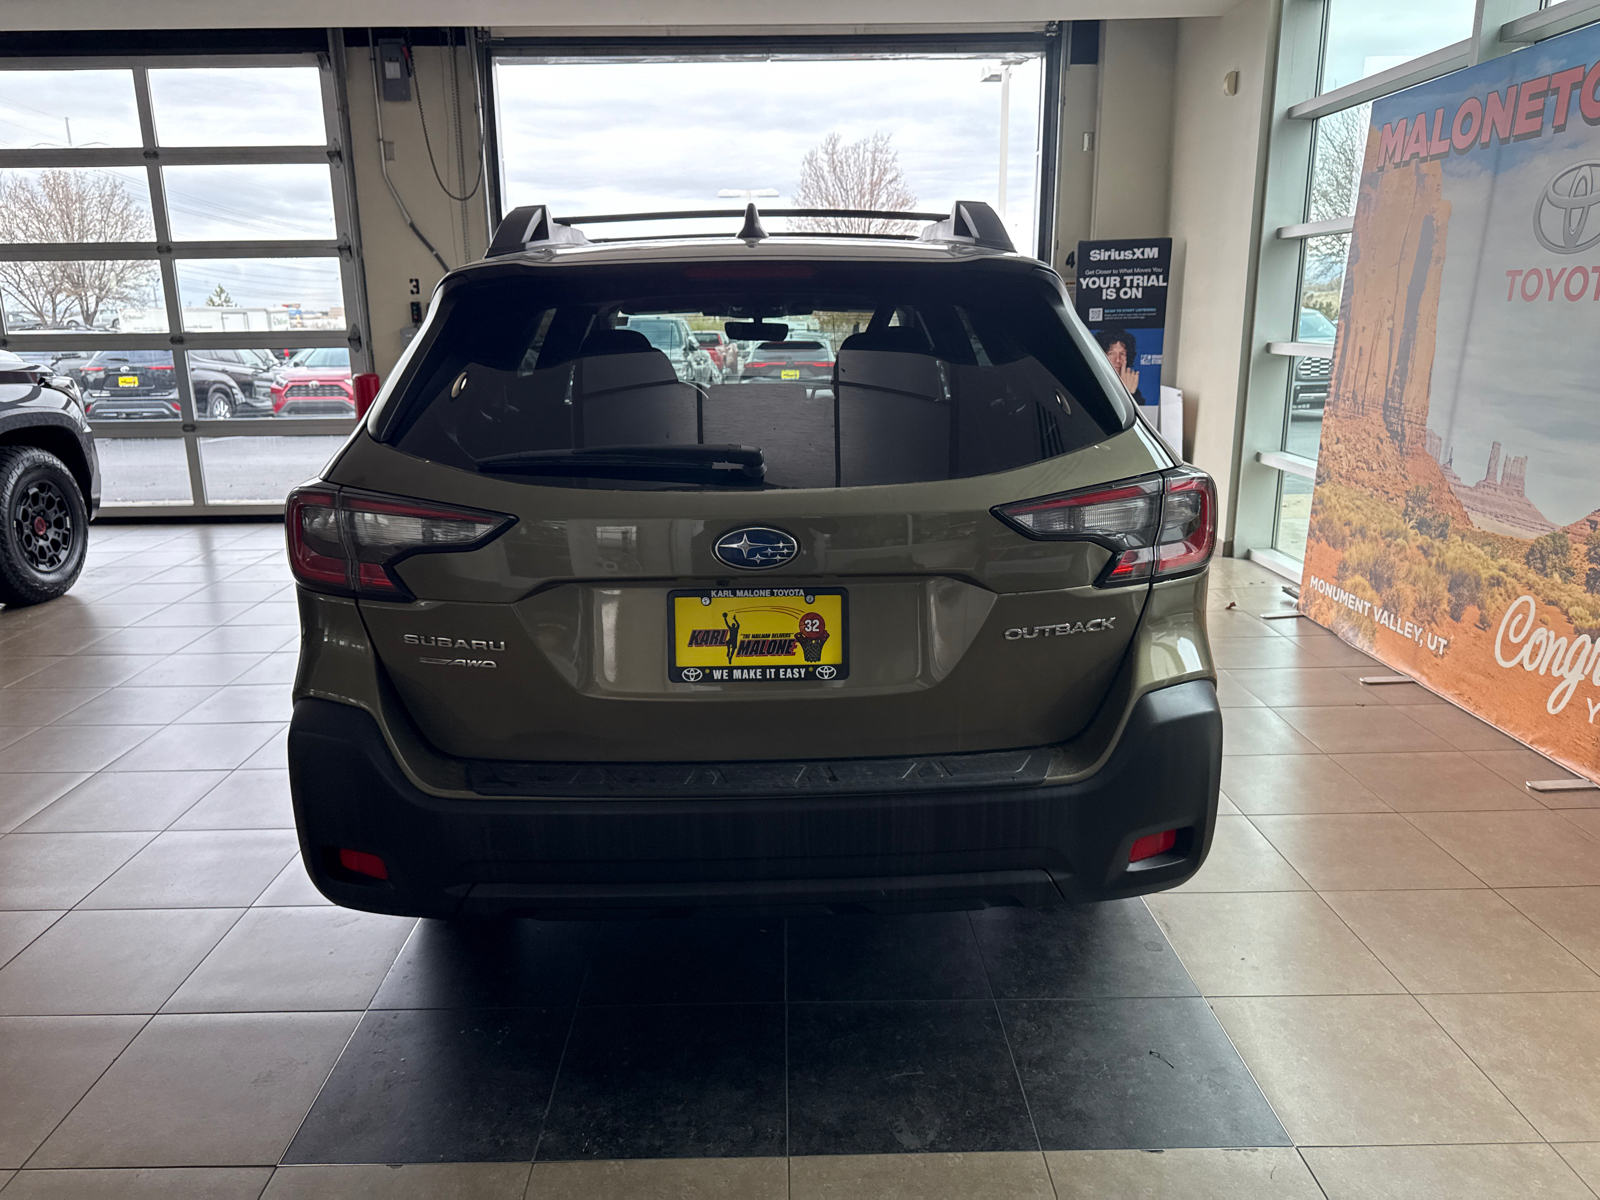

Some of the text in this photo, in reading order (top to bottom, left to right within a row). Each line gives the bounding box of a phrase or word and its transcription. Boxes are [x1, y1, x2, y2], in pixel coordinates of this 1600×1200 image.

[1065, 251, 1076, 268] 4
[1089, 247, 1159, 261] SiriusXM
[409, 278, 420, 295] 3
[1079, 274, 1168, 289] YOUR TRIAL
[1102, 287, 1143, 300] IS ON
[711, 589, 805, 598] KARL MALONE TOYOTA
[1310, 575, 1448, 655] MONUMENT VALLEY, UT
[804, 619, 820, 632] 32
[1004, 617, 1116, 640] OUTBACK
[403, 634, 506, 651] SUBARU
[688, 629, 730, 647] KARL
[736, 639, 798, 657] MALONE
[447, 658, 497, 668] AWD
[713, 668, 806, 680] WE MAKE IT EASY
